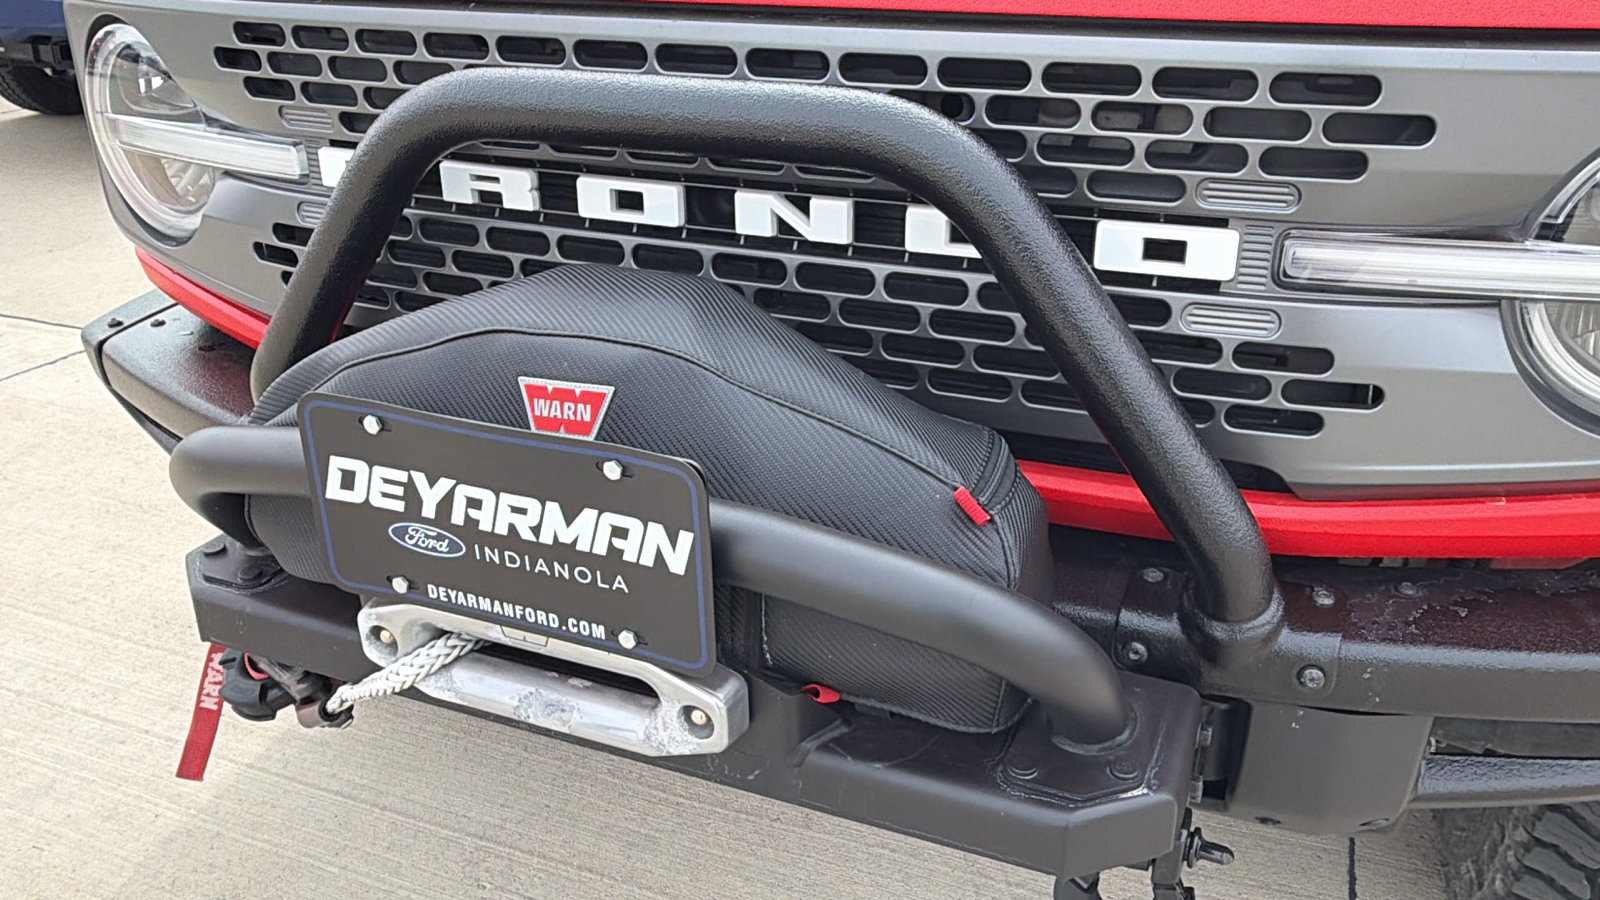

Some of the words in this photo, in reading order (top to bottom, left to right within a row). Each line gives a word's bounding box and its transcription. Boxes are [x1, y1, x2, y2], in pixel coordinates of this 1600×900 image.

[318, 146, 1241, 282] RONO
[533, 397, 591, 422] WARN
[325, 455, 694, 576] DEYARMAN
[404, 526, 450, 553] Ford
[474, 543, 630, 594] INDIANOLA
[427, 583, 606, 640] DEYARMANFORD.COM
[199, 652, 224, 711] WARN
